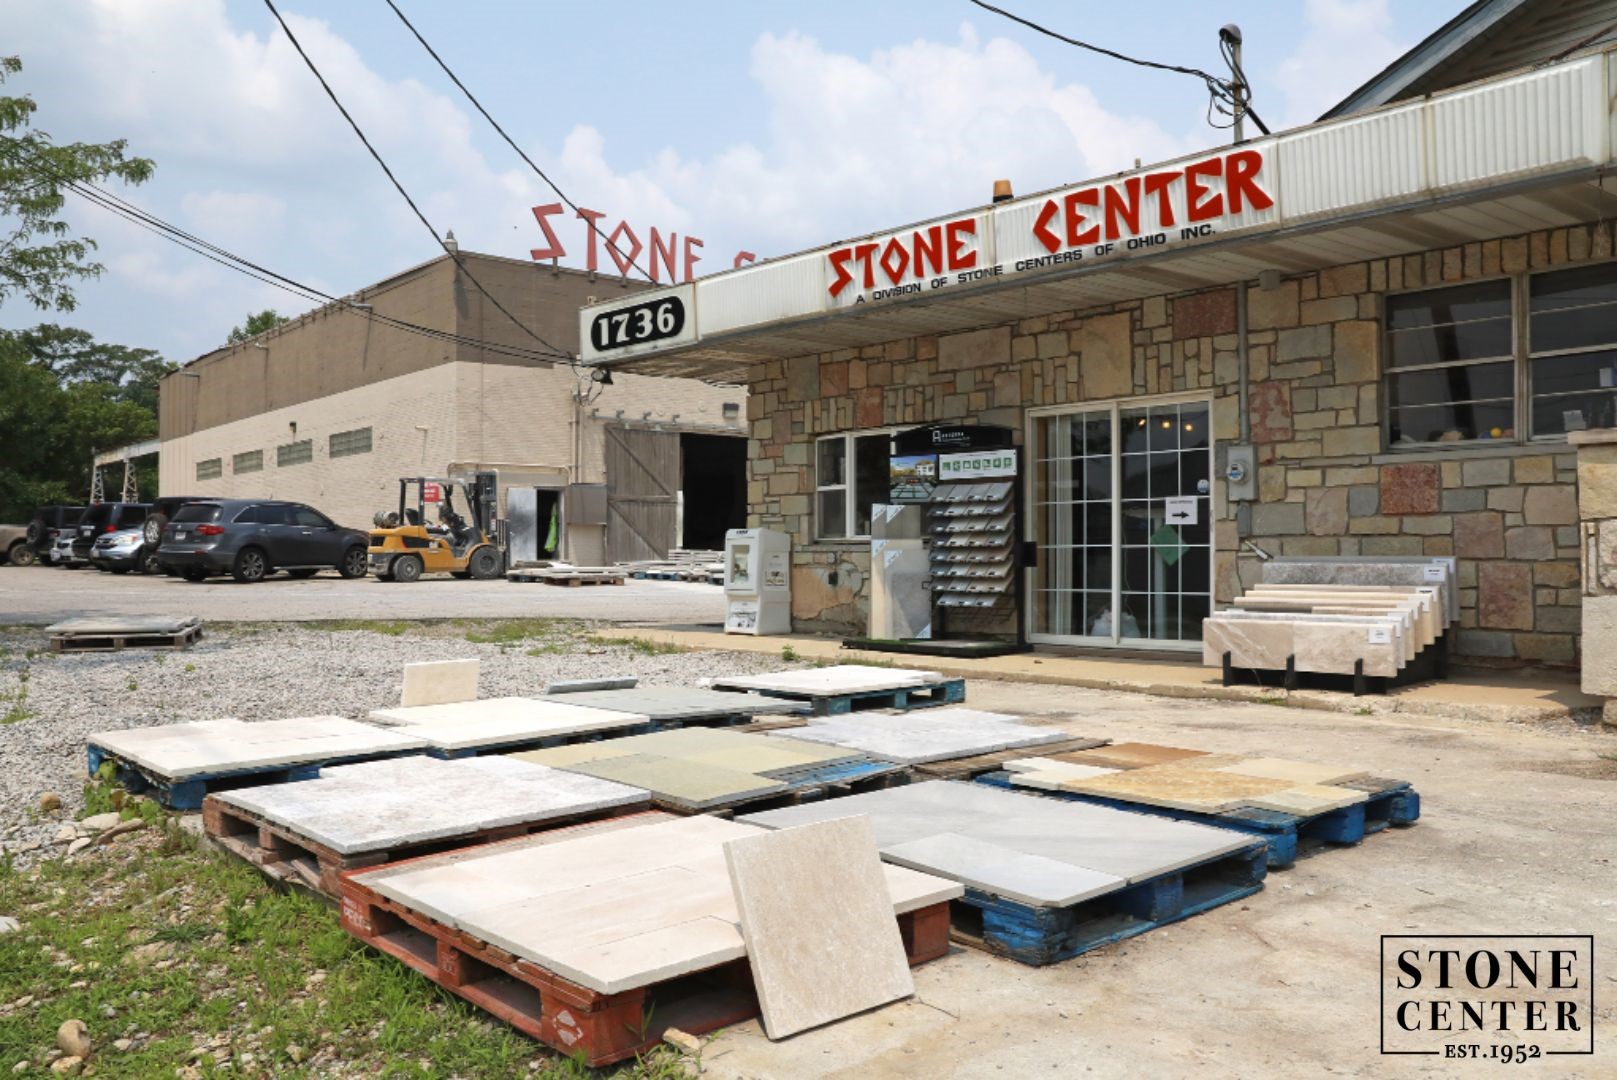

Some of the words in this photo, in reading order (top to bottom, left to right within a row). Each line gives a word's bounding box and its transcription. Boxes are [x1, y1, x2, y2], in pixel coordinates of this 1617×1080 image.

[530, 203, 704, 283] STONE
[828, 218, 976, 298] STONE
[1033, 150, 1274, 254] CENTER
[856, 295, 865, 304] A
[873, 283, 921, 300] DIVISION
[931, 277, 948, 289] OF
[958, 265, 1003, 283] STONE
[1015, 249, 1082, 271] CENTERS
[1094, 243, 1114, 256] OF
[1127, 233, 1166, 250] OHIO
[1181, 224, 1216, 240] INC.
[598, 302, 676, 346] 1736
